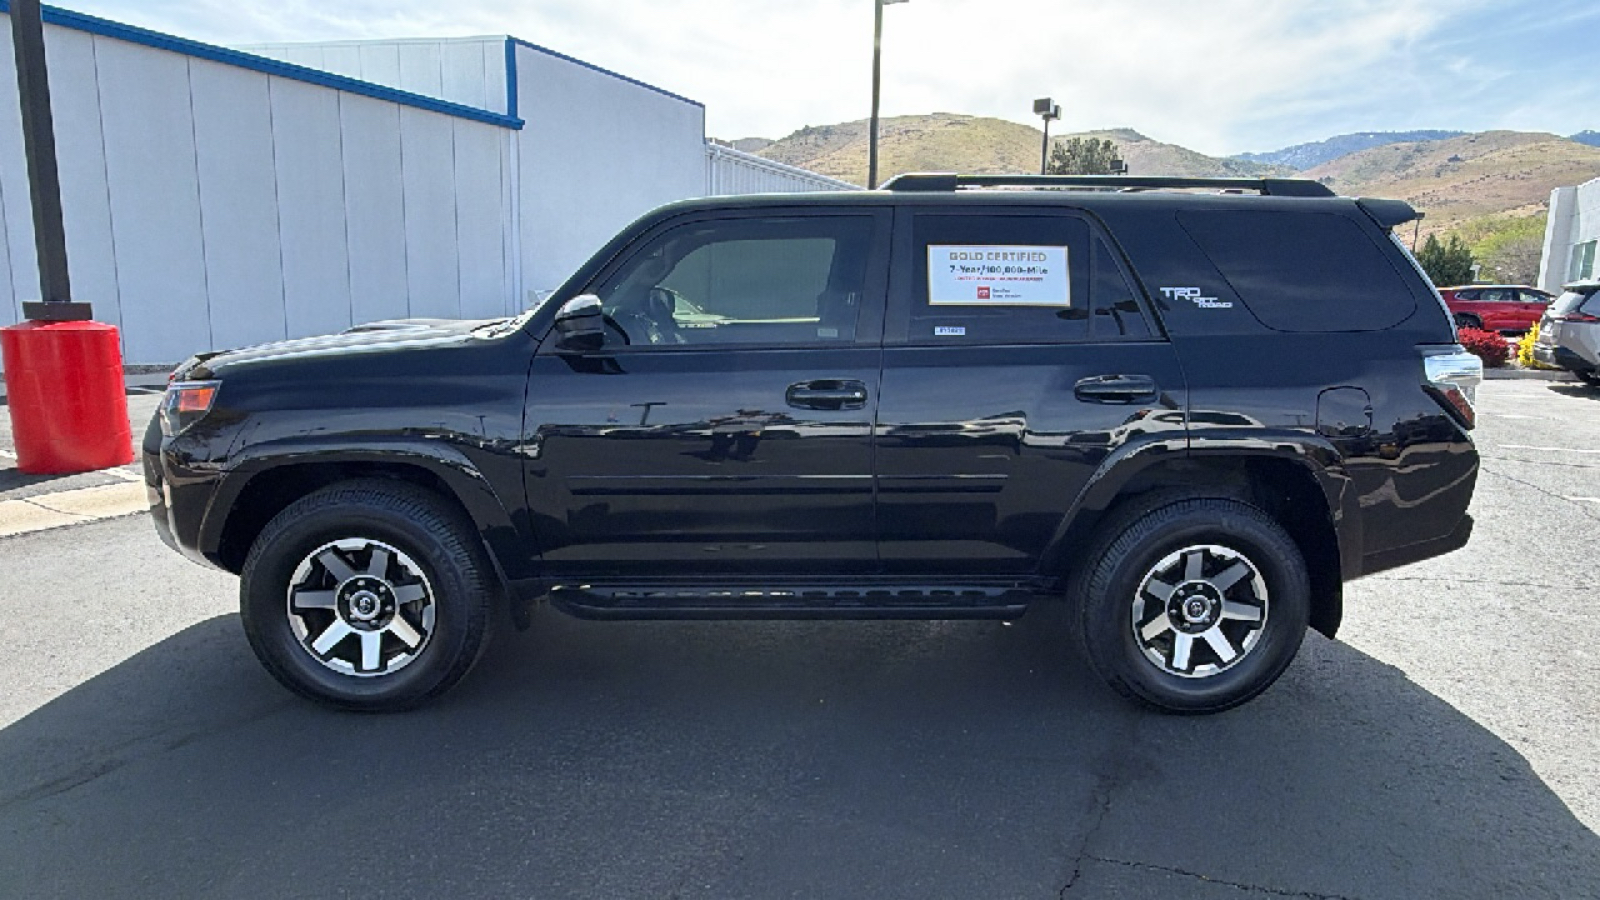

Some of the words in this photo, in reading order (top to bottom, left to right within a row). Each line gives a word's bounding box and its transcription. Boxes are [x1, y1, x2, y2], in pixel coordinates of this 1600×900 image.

[949, 252, 983, 261] GOLD
[987, 252, 1047, 262] CERTIFIED
[949, 264, 1048, 276] 7-Year/100,000-Mile
[1160, 287, 1200, 300] TRD
